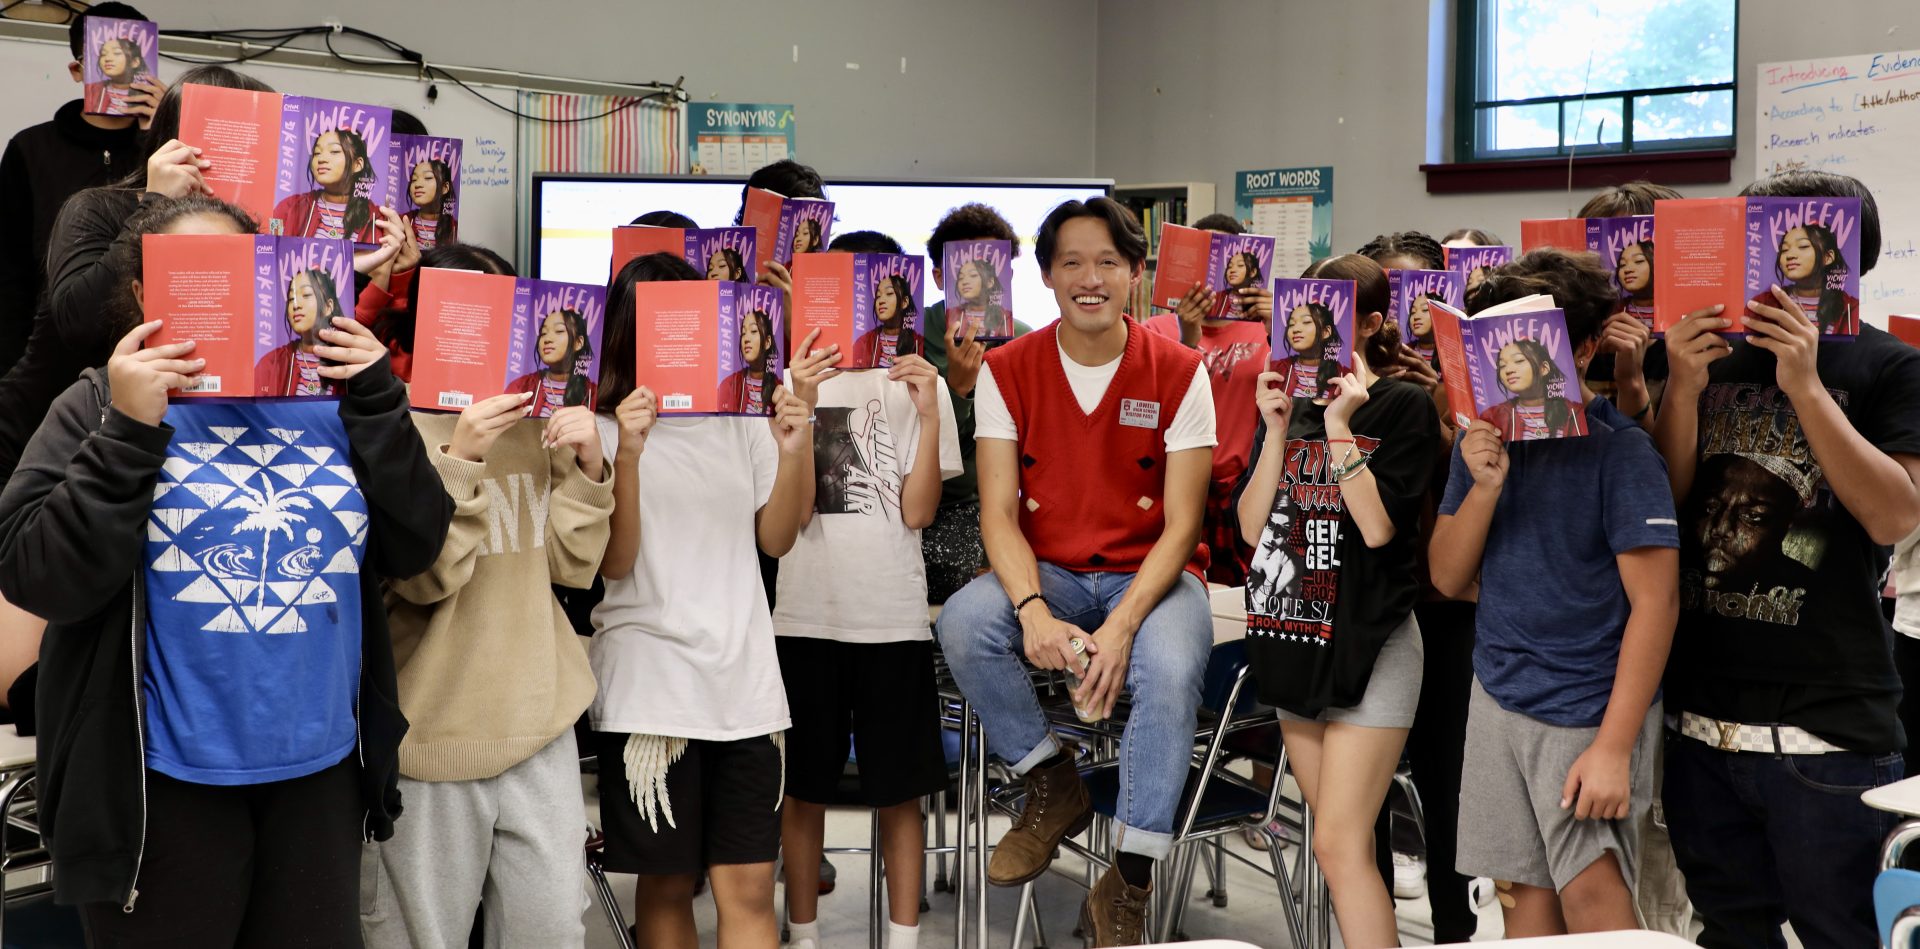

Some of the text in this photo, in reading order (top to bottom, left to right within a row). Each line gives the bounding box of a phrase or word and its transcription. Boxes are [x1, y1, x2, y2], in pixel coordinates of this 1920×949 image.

[91, 21, 154, 57] KWEEN
[1766, 63, 1848, 86] Introducing
[706, 108, 776, 128] SYNONYMS
[1829, 97, 1843, 112] to
[305, 106, 385, 158] KWEEN
[279, 131, 297, 192] KWEEN
[405, 140, 461, 182] KWEEN
[1246, 169, 1320, 189] ROOT WORDS
[354, 189, 371, 200] CHUM
[793, 202, 831, 236] KWEEN
[1770, 201, 1854, 252] KWEEN
[701, 230, 753, 271] KWEEN
[950, 242, 1006, 281] KWEEN
[1223, 236, 1270, 270] KWEEN
[1607, 219, 1654, 269] KWE
[1748, 231, 1763, 291] KWEEN
[279, 243, 351, 302] KWEEN
[870, 256, 921, 298] KWEEN
[1826, 281, 1845, 291] CHUM
[1827, 274, 1847, 282] VICHET
[257, 275, 274, 347] KWEEN
[534, 286, 602, 337] KWEEN
[736, 289, 781, 336] KWEEN
[854, 283, 867, 331] KWEEN
[1280, 283, 1349, 327] KWEEN
[1404, 274, 1457, 316] KWEEN
[510, 313, 528, 375] KWEEN
[720, 313, 733, 371] KWEEN
[1481, 318, 1560, 370] KWEEN
[1467, 349, 1486, 406] KWEEN
[1547, 389, 1565, 398] CHUM
[844, 464, 876, 516] AIR
[480, 473, 551, 556] NY
[1256, 617, 1320, 633] ROCK MYTHO
